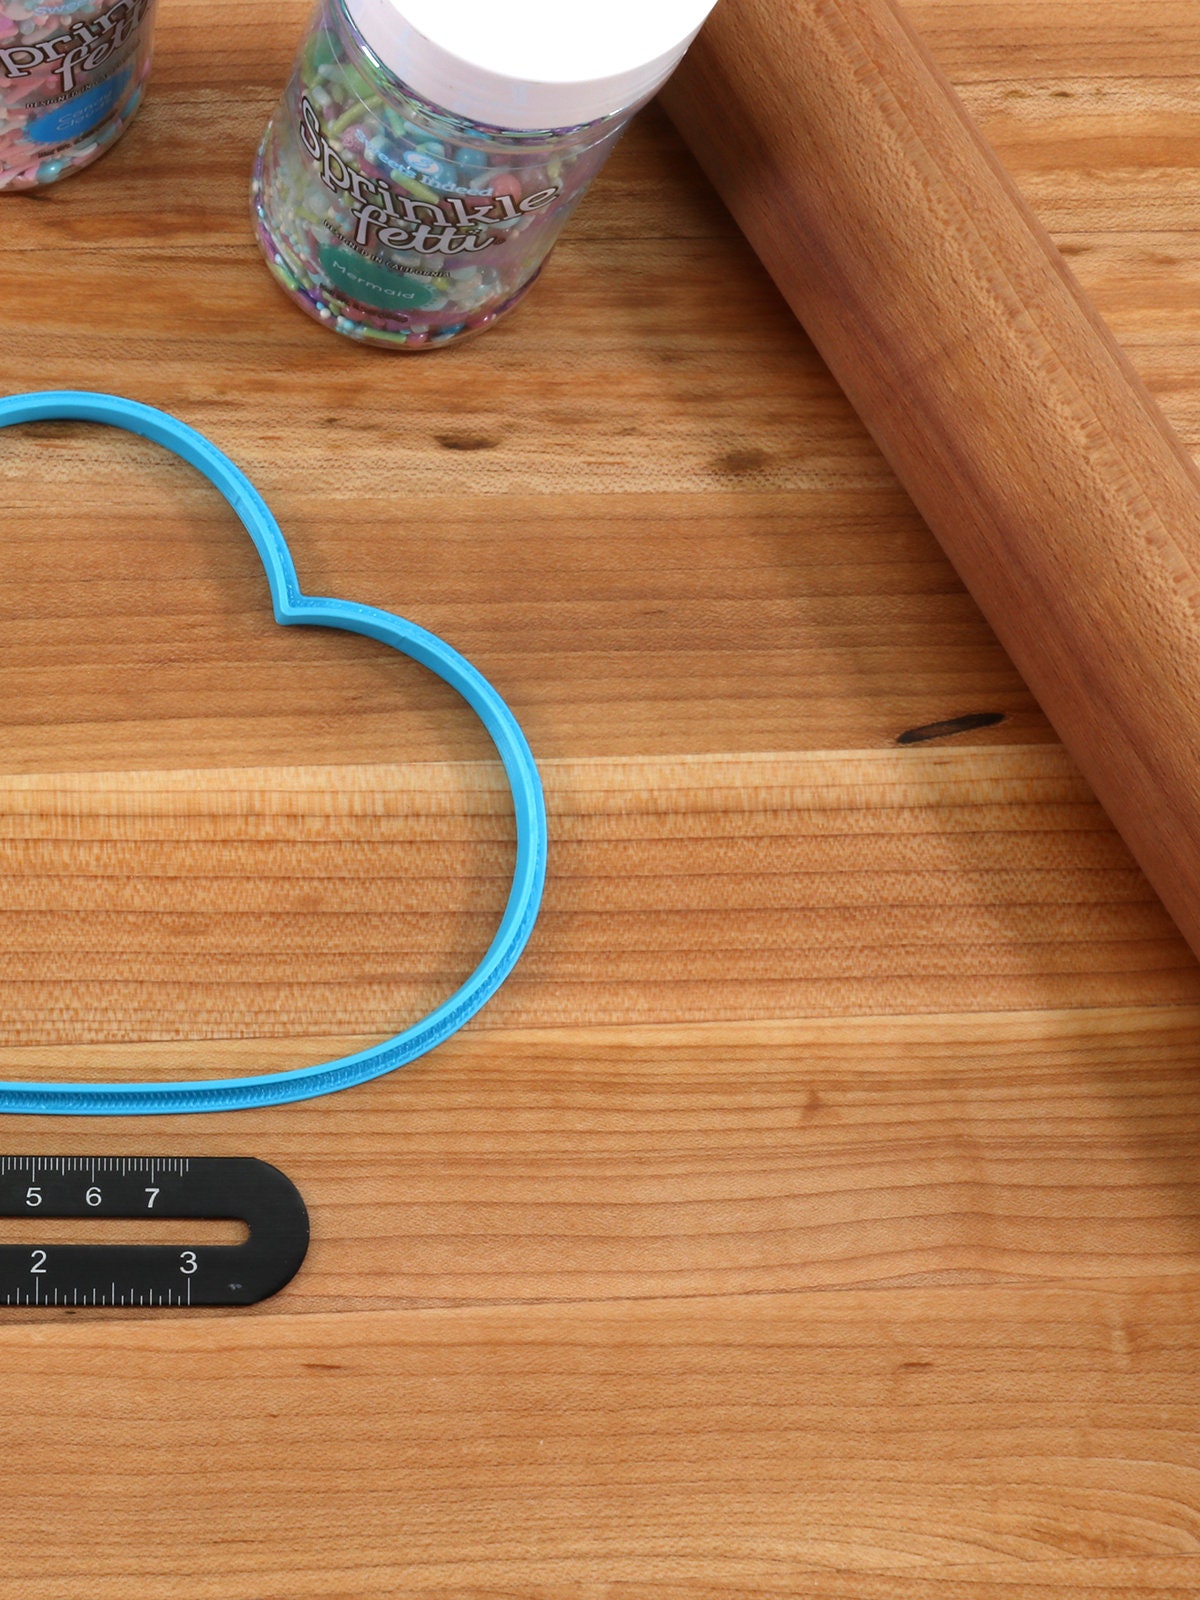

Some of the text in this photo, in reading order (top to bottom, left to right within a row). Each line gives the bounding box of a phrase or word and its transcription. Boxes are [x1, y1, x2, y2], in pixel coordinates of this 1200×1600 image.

[300, 96, 560, 229] Sprinkle
[351, 201, 496, 255] fetti
[332, 259, 416, 300] Mermaid
[384, 259, 452, 278] CALIFORNIA
[25, 1186, 43, 1207] 5
[85, 1186, 102, 1207] 6
[144, 1187, 160, 1209] 7
[30, 1249, 47, 1274] 2
[179, 1250, 198, 1274] 3
